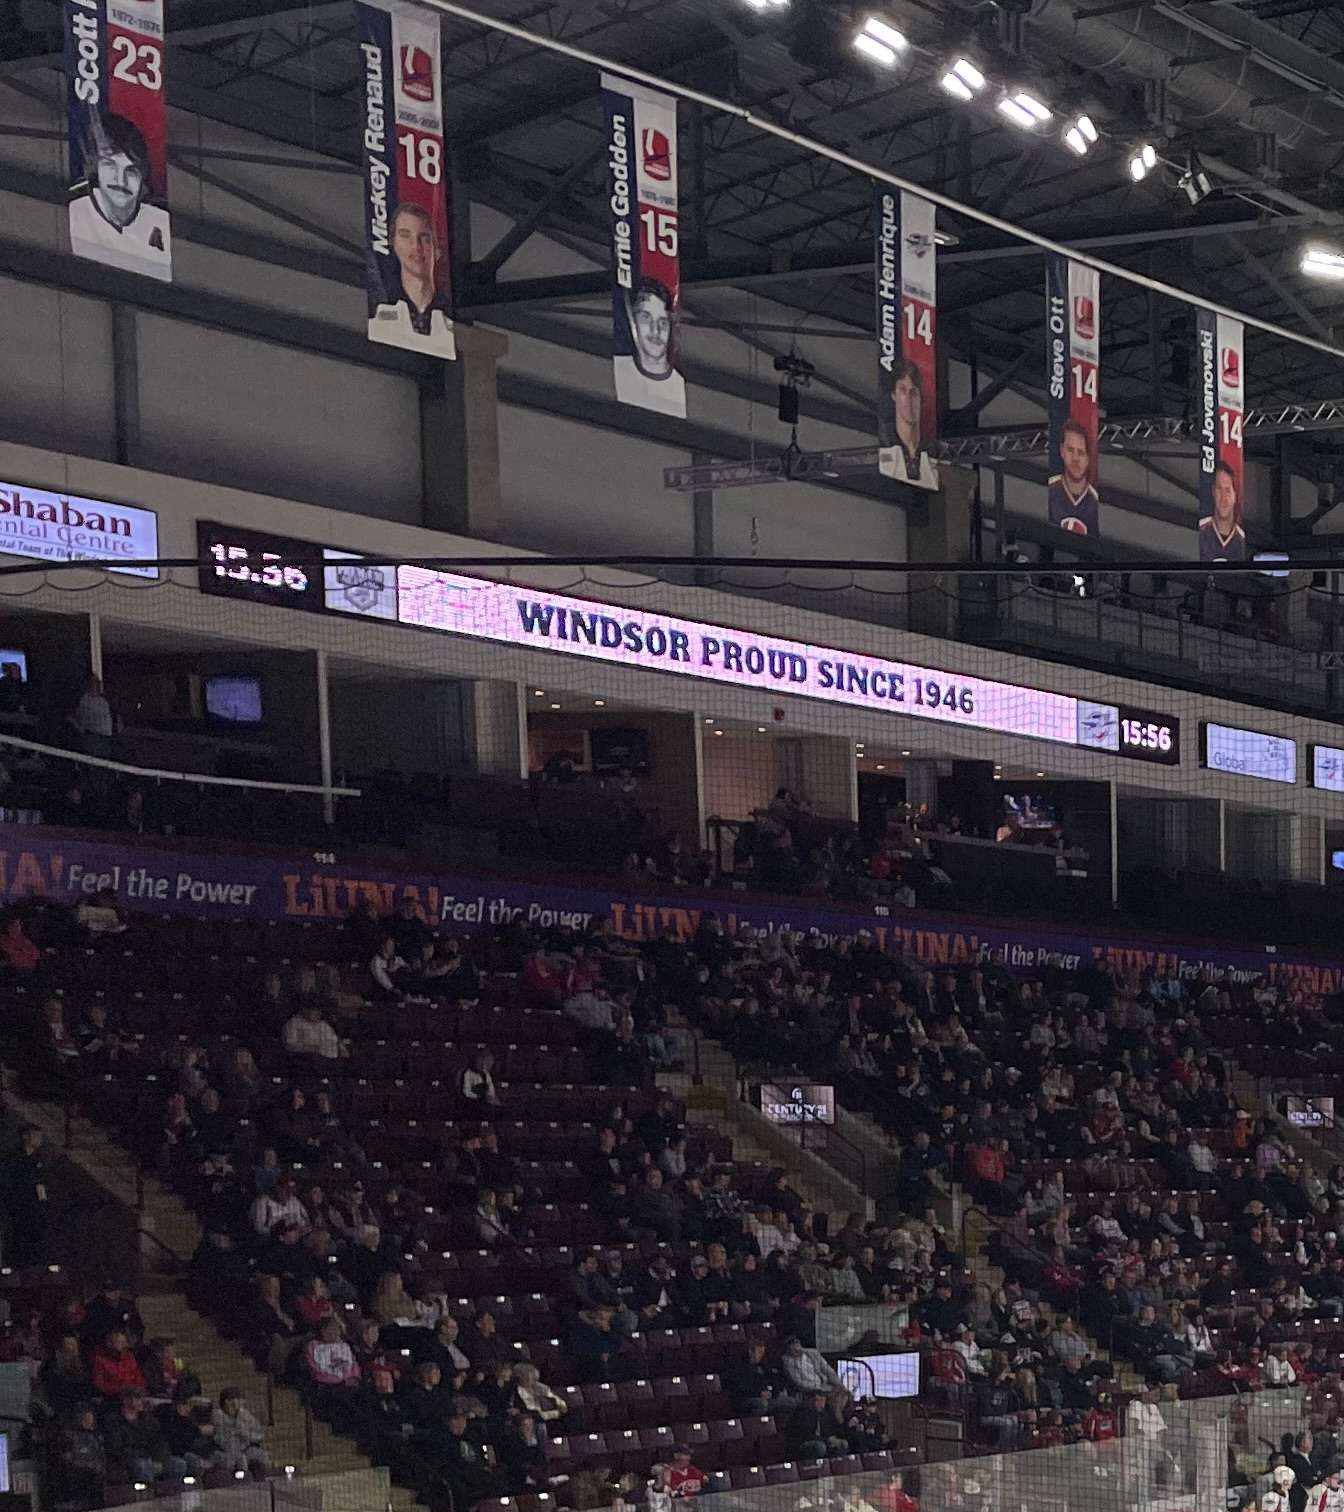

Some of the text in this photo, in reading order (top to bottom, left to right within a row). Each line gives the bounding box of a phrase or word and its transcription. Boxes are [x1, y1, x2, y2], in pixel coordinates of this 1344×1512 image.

[73, 12, 99, 104] Scott
[112, 36, 162, 90] 23
[361, 42, 390, 255] Mickey Renaud
[399, 133, 441, 185] 18
[609, 114, 632, 289] Ernie Godden
[640, 210, 678, 257] 15
[879, 195, 897, 372] Adam Henrique
[903, 303, 933, 346] 14
[1050, 296, 1065, 399] Steve Ott
[1072, 364, 1097, 403] 14
[1200, 330, 1215, 473] Ed Jovanovski
[1220, 411, 1243, 449] 14
[0, 489, 132, 537] Shaban
[0, 519, 48, 540] ntal
[516, 600, 974, 713] WINDSOR PROUD SINCE 1946
[1121, 719, 1171, 751] 15:56
[68, 865, 120, 893] Feel
[127, 868, 169, 900] the
[176, 872, 257, 905] Power
[441, 895, 486, 922] Feel
